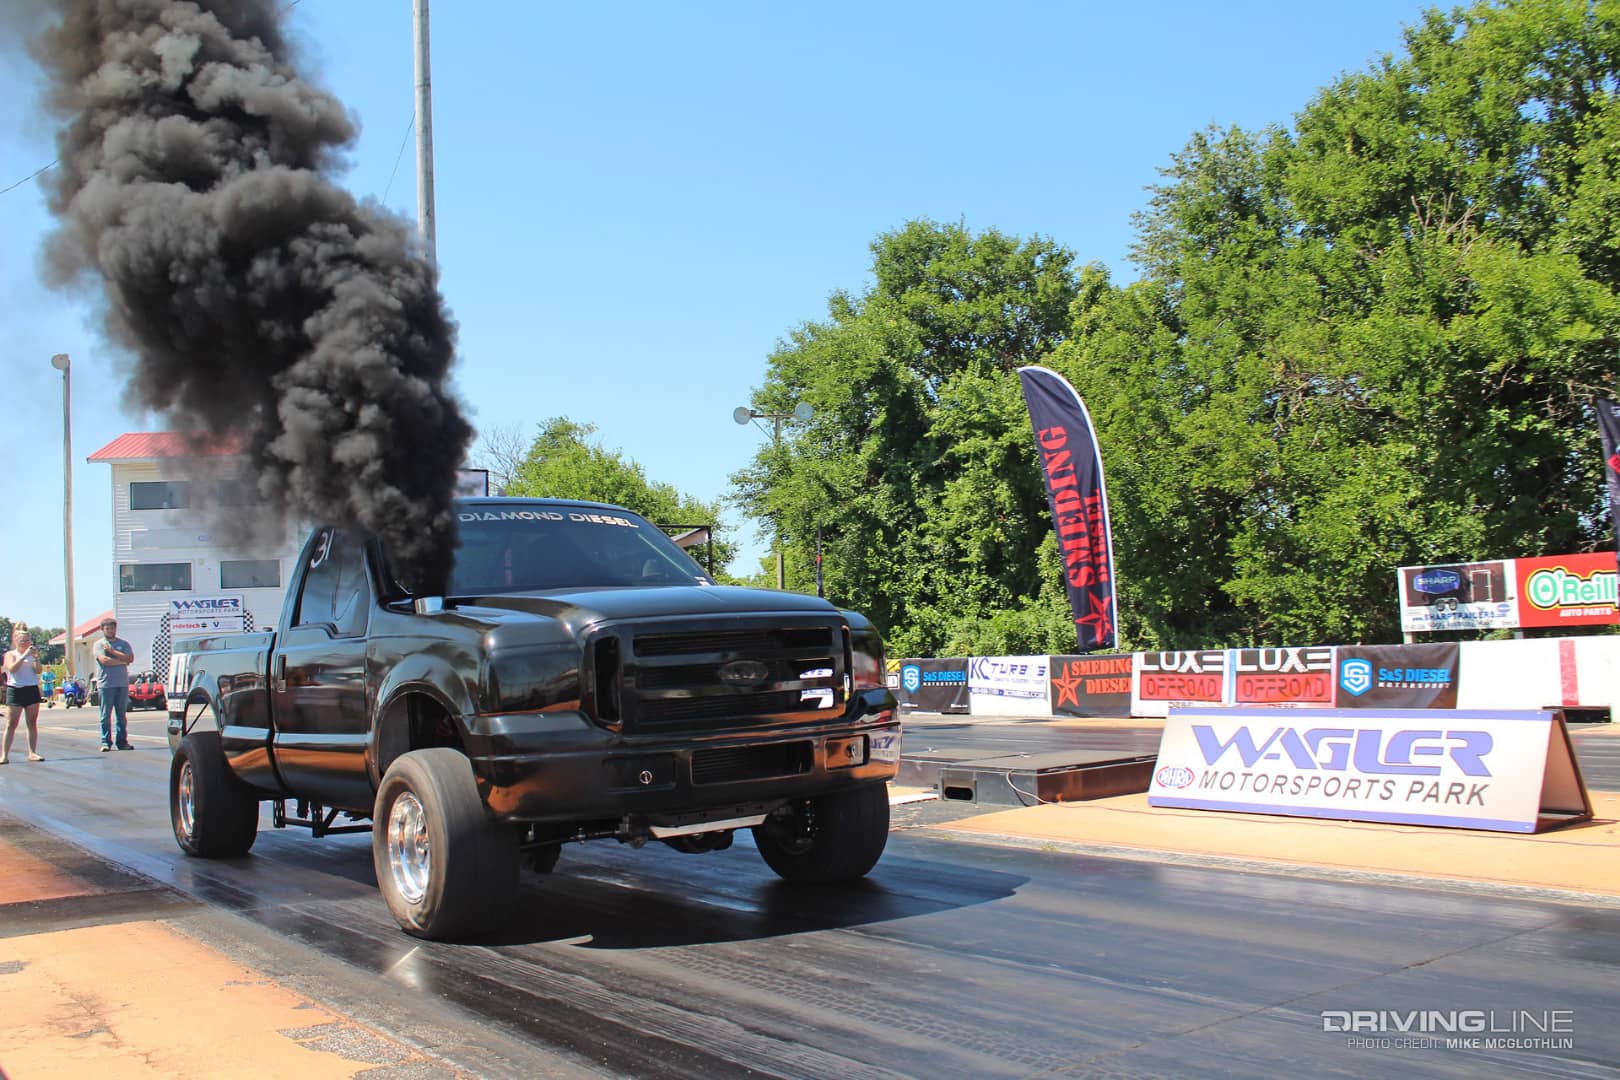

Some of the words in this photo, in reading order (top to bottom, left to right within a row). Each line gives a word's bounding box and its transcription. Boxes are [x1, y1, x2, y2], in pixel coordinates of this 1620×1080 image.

[1038, 425, 1096, 589] SMEDING
[457, 511, 563, 522] DIAMOND
[568, 513, 639, 528] DIESEL
[1083, 488, 1109, 583] DIESEL
[1417, 575, 1457, 585] SHARP
[1532, 572, 1617, 604] O'Reill
[172, 598, 240, 610] WAGLER
[1559, 609, 1582, 617] AUTO
[1583, 607, 1613, 616] PARTS
[970, 656, 990, 680] KC
[991, 662, 1047, 677] TURBS
[1071, 657, 1133, 676] SMEDING
[1140, 651, 1224, 673] LUXE
[1237, 649, 1332, 672] LUXE
[938, 671, 966, 681] DIESEL
[1378, 668, 1403, 682] S&S
[1405, 668, 1452, 682] DIESEL
[1146, 678, 1217, 697] OFFROAD
[1243, 676, 1325, 698] OFFROAD
[1191, 725, 1494, 777] WAGLER
[1198, 769, 1397, 800] MOTORSPORTS
[1405, 781, 1491, 806] PARK
